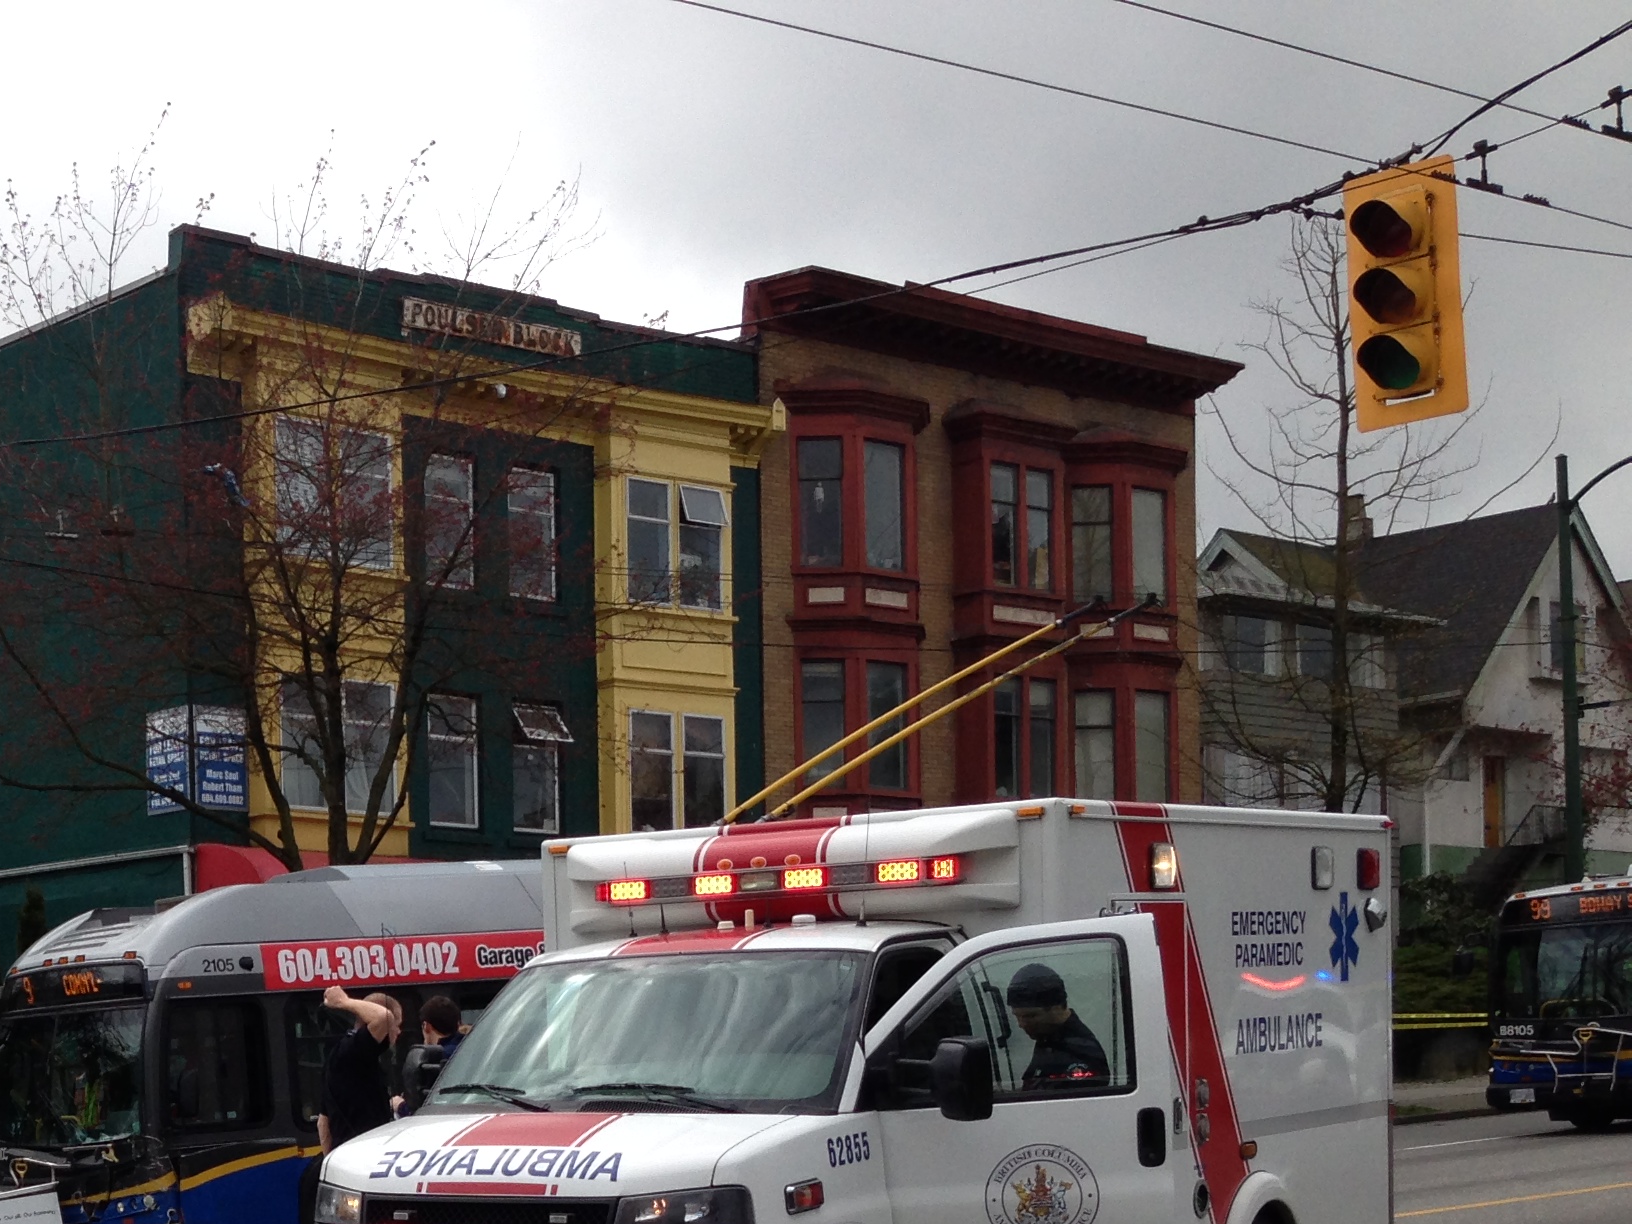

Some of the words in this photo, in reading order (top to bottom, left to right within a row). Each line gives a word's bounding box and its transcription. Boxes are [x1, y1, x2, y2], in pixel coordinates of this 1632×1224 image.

[513, 323, 575, 356] BLOCK
[202, 781, 225, 792] Robert
[1530, 898, 1551, 919] 99
[1231, 911, 1306, 936] EMERGENCY
[203, 958, 235, 973] 2105
[277, 941, 460, 984] 604.303.0402
[477, 944, 535, 969] Garage
[1235, 942, 1304, 968] PARAMEDIC
[22, 976, 34, 1004] 9
[1235, 1013, 1323, 1055] AMBULANCE
[827, 1131, 870, 1168] 62855
[993, 1149, 1032, 1185] BRITISH
[1035, 1148, 1088, 1180] COLUMBIA
